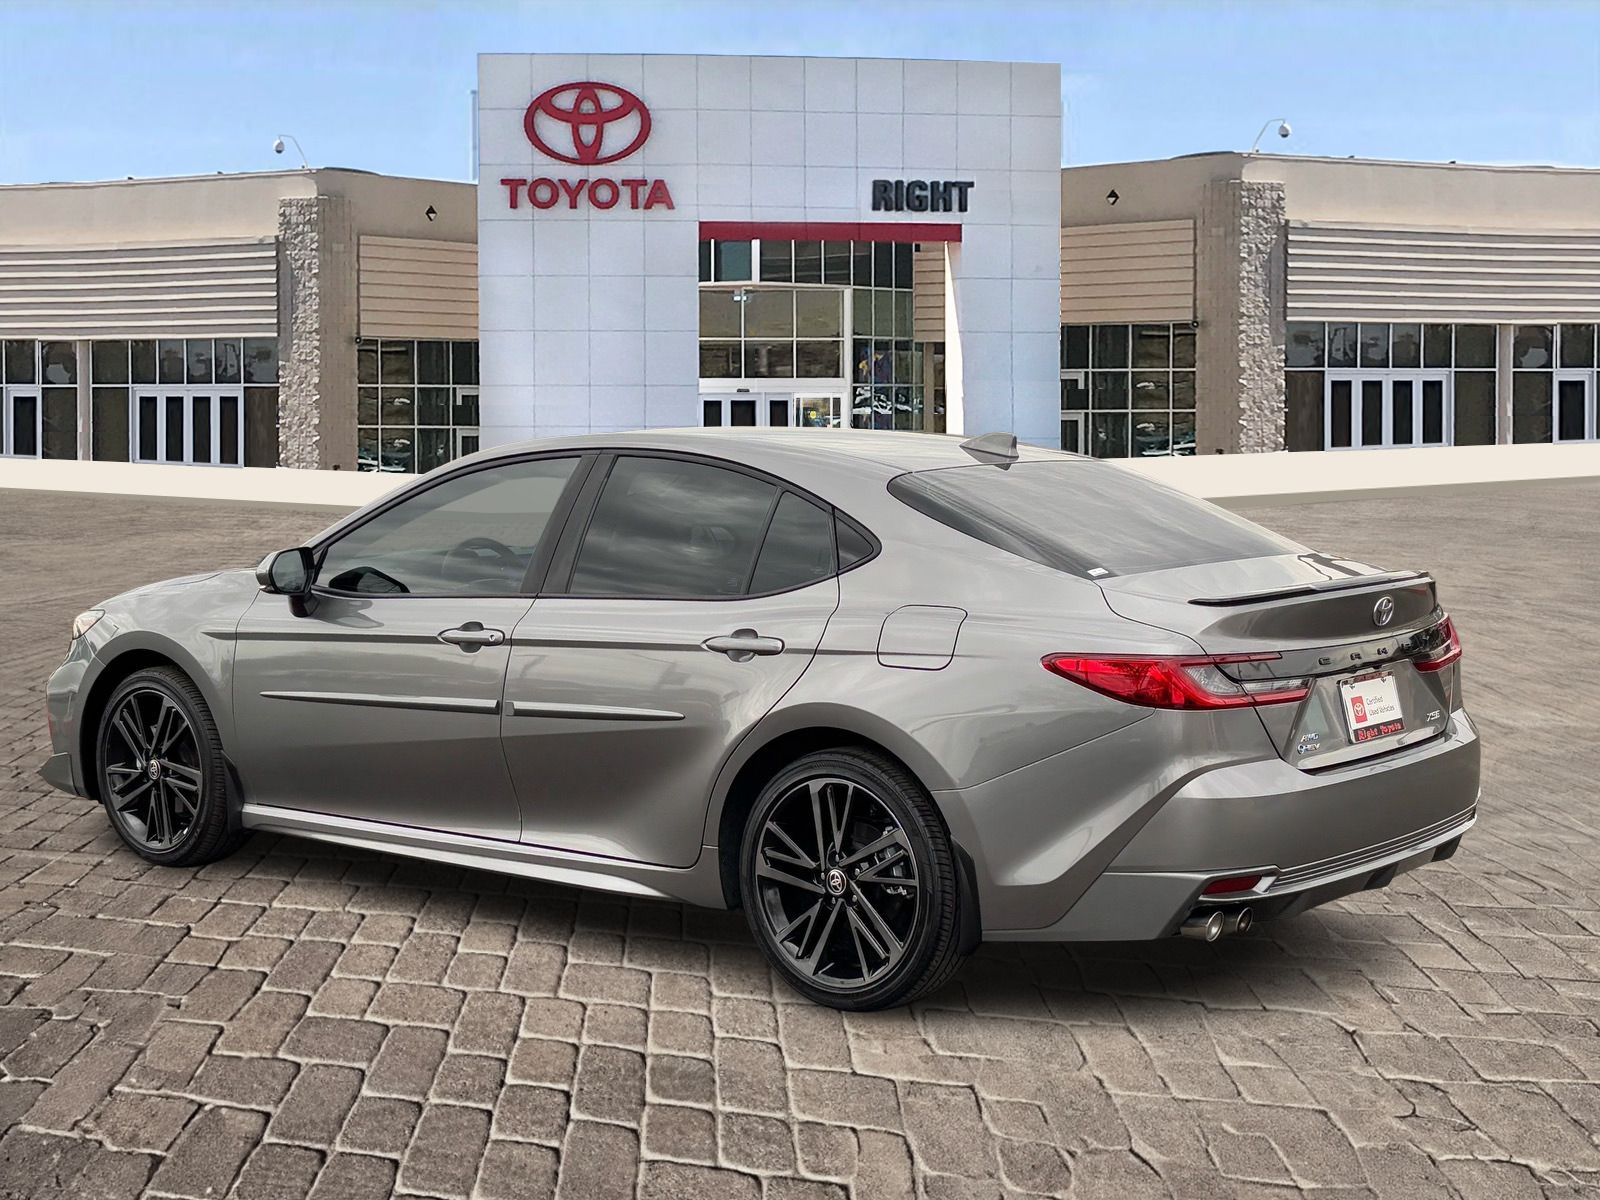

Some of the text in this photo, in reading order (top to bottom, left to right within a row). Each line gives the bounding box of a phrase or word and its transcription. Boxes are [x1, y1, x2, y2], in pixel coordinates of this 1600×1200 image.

[500, 178, 675, 209] TOYOTA
[872, 179, 975, 212] RIGHT
[1366, 695, 1384, 706] Certified
[1358, 722, 1402, 740] Right Toyota
